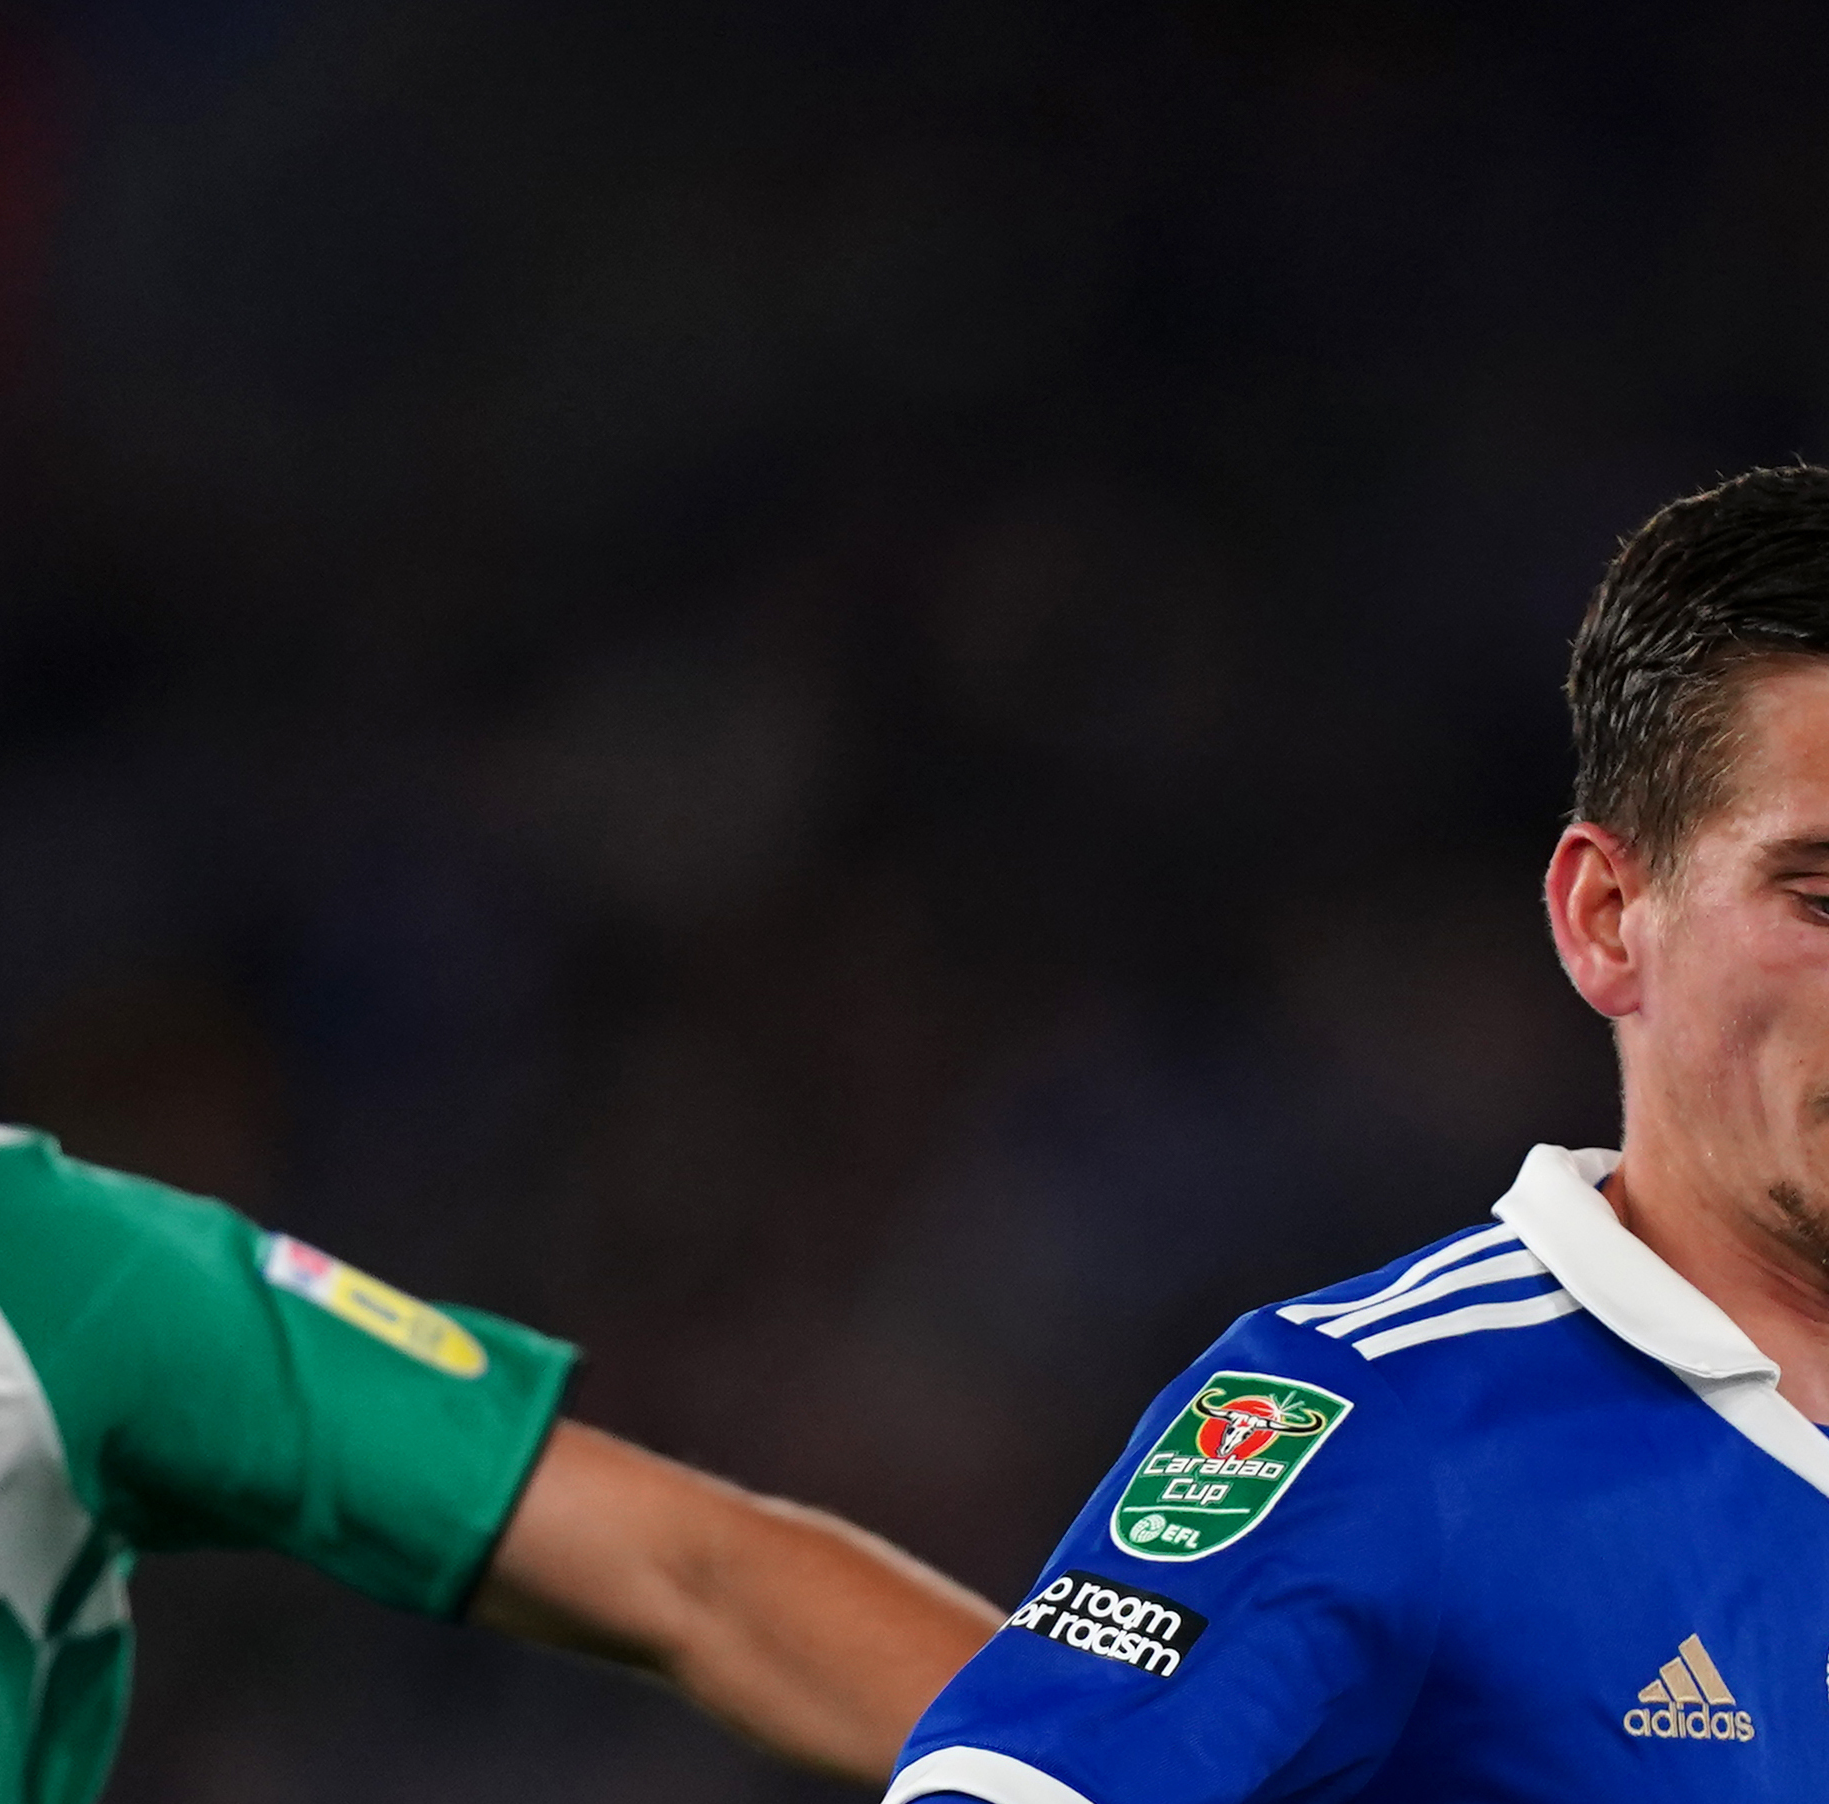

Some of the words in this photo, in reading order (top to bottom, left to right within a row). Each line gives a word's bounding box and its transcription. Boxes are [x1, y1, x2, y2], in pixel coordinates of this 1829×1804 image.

[1142, 1452, 1285, 1480] Carabao
[1161, 1477, 1230, 1506] Cup
[1160, 1523, 1202, 1549] EFL
[1033, 1576, 1074, 1602] o
[1070, 1581, 1182, 1641] room
[1049, 1611, 1181, 1677] racism
[1623, 1699, 1755, 1742] adidas
